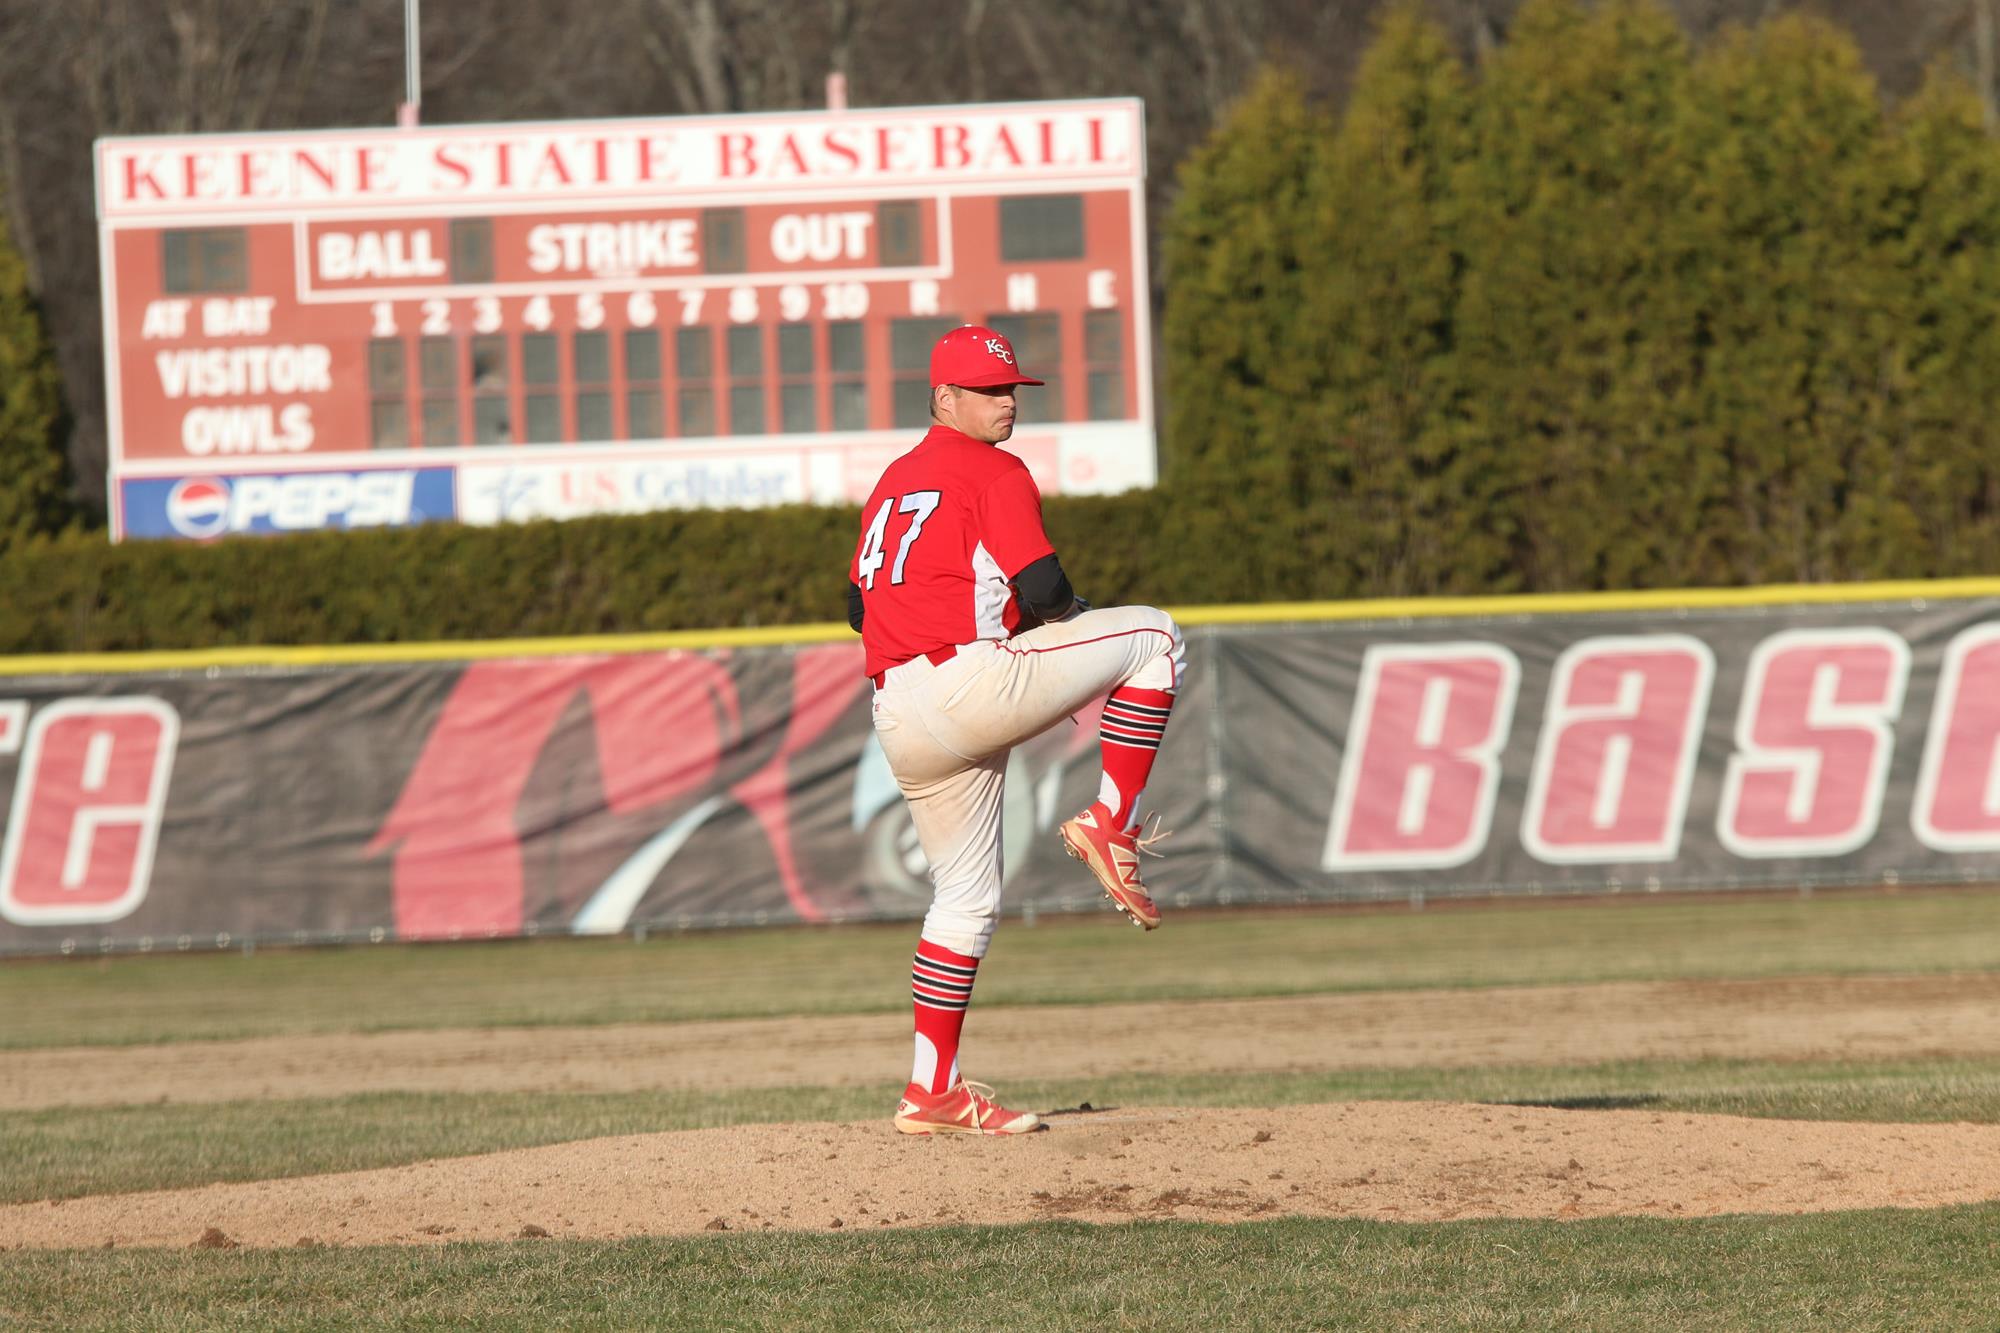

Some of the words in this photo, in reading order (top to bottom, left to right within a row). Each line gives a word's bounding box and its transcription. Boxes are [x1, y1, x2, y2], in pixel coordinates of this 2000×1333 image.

[120, 147, 399, 202] KEENE
[431, 136, 677, 191] STATE
[717, 117, 1129, 178] BASEBALL
[319, 230, 444, 280] BALL
[527, 218, 699, 273] STRIKE
[769, 211, 874, 263] OUT
[142, 302, 192, 338] AT
[202, 298, 274, 336] BAT
[370, 301, 397, 336] 1
[420, 299, 452, 335] 2
[471, 298, 503, 333] 3
[522, 296, 553, 331] 4
[574, 293, 605, 329] 5
[626, 291, 658, 328] 6
[678, 288, 707, 325] 7
[728, 286, 760, 324] 8
[780, 284, 810, 321] 9
[822, 282, 870, 319] 10
[910, 279, 940, 316] R
[1007, 273, 1037, 312] H
[1087, 269, 1117, 309] E
[155, 346, 332, 398] VISITOR
[984, 338, 1014, 365] KSC
[181, 403, 315, 456] OWLS
[228, 470, 418, 530] PEPSI
[858, 490, 942, 591] 47
[0, 695, 181, 926] e
